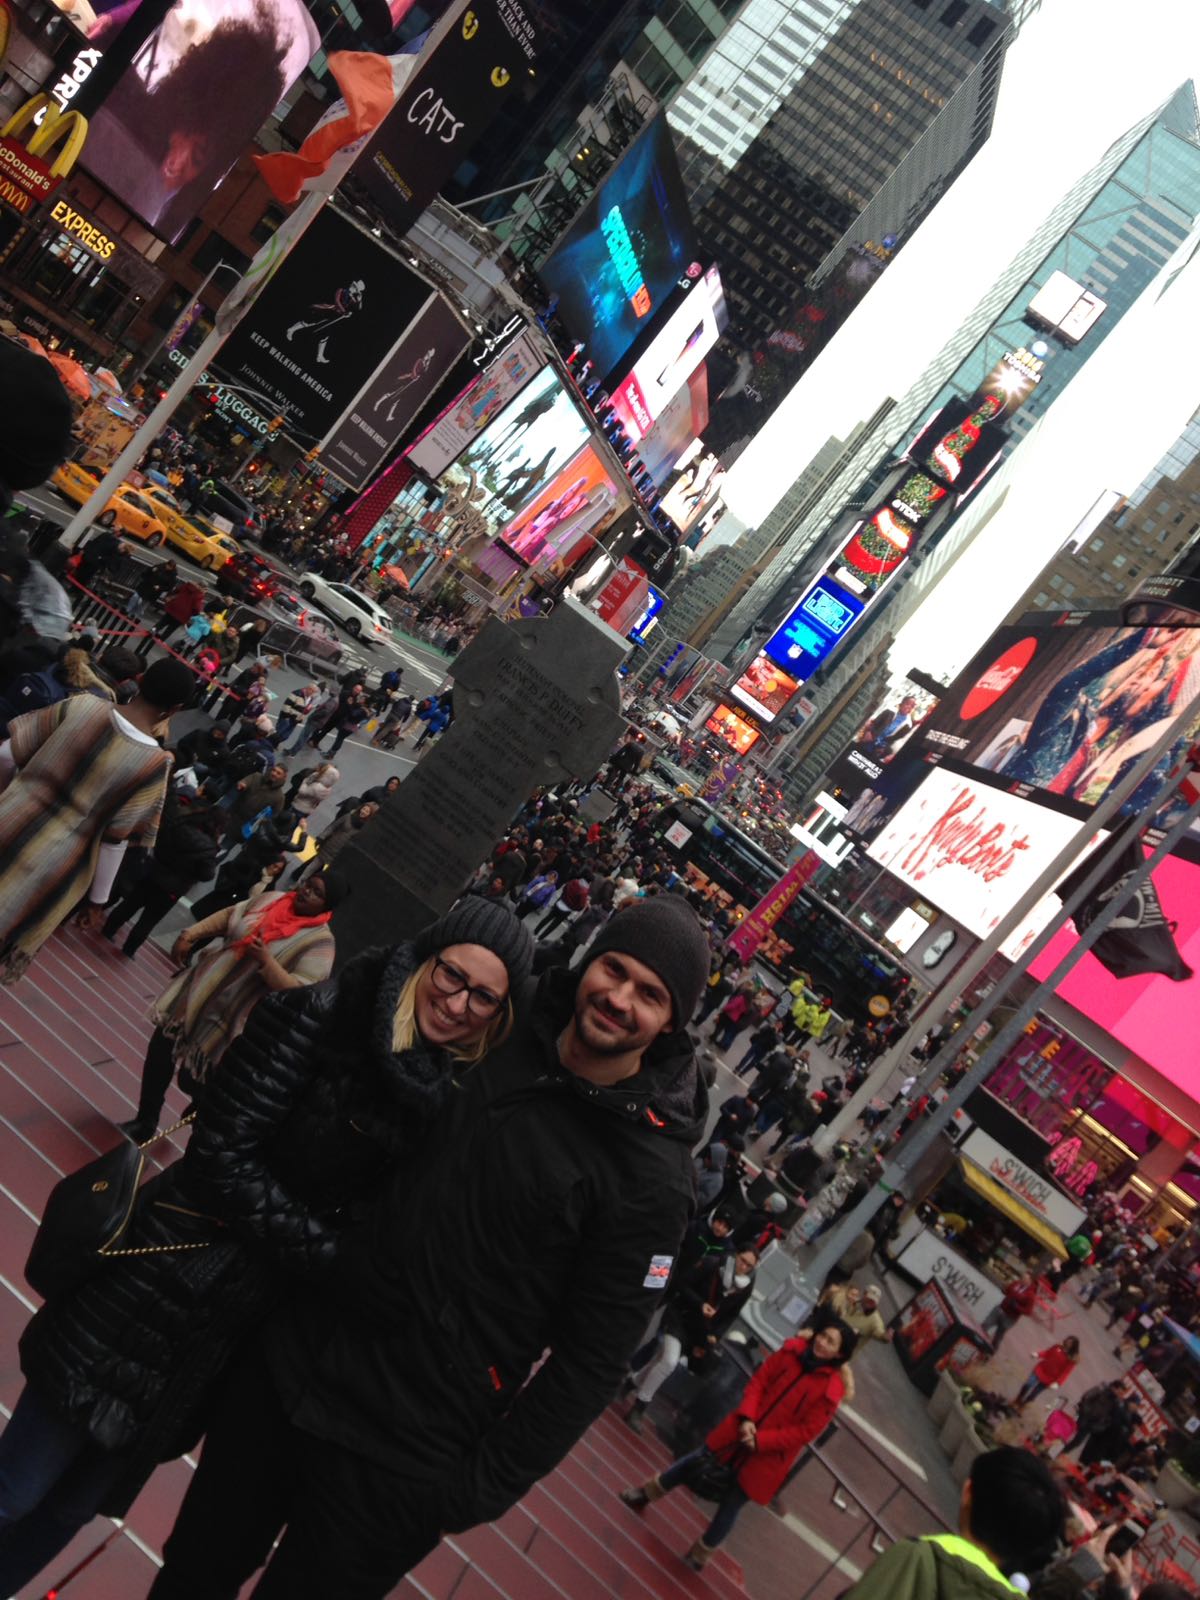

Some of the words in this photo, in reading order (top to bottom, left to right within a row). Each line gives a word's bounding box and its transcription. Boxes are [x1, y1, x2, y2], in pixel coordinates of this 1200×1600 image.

[504, 7, 522, 35] THAN
[517, 32, 537, 60] EVER!
[521, 19, 536, 40] AND
[408, 87, 464, 143] CATS
[0, 145, 52, 190] cDonald's
[49, 199, 117, 260] EXPRESS
[677, 275, 692, 290] LG
[248, 330, 270, 351] KEEP
[267, 345, 302, 377] WALKING
[299, 371, 335, 402] AMERICA
[1002, 351, 1042, 383] TOSHIBA
[901, 786, 985, 880] Kinky
[959, 822, 1031, 882] Boots
